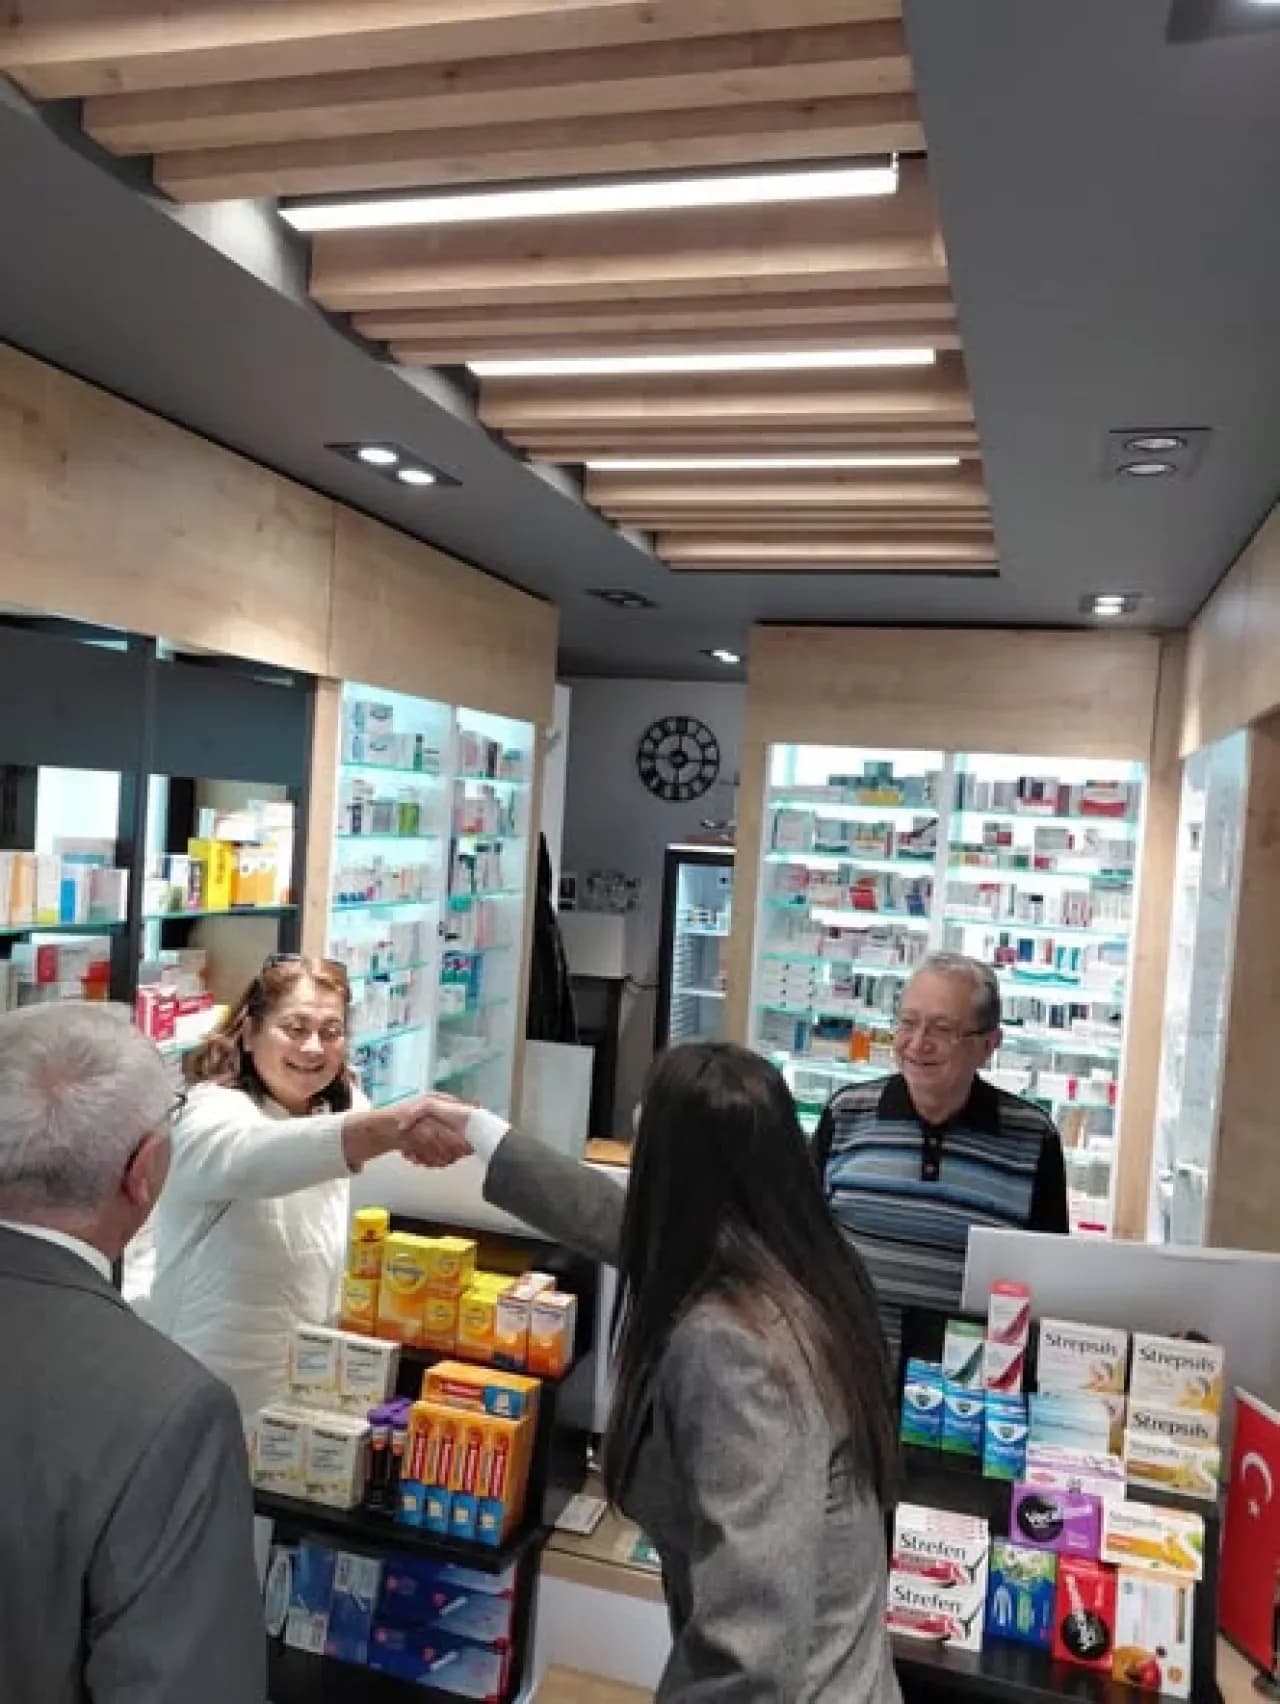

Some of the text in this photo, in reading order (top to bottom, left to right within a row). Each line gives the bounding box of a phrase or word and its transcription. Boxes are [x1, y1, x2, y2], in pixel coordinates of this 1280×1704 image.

[1045, 1332, 1118, 1355] Strepsils
[1138, 1348, 1216, 1373] Strepsils
[1133, 1412, 1209, 1438] Strepsils
[900, 1532, 966, 1560] Strefen
